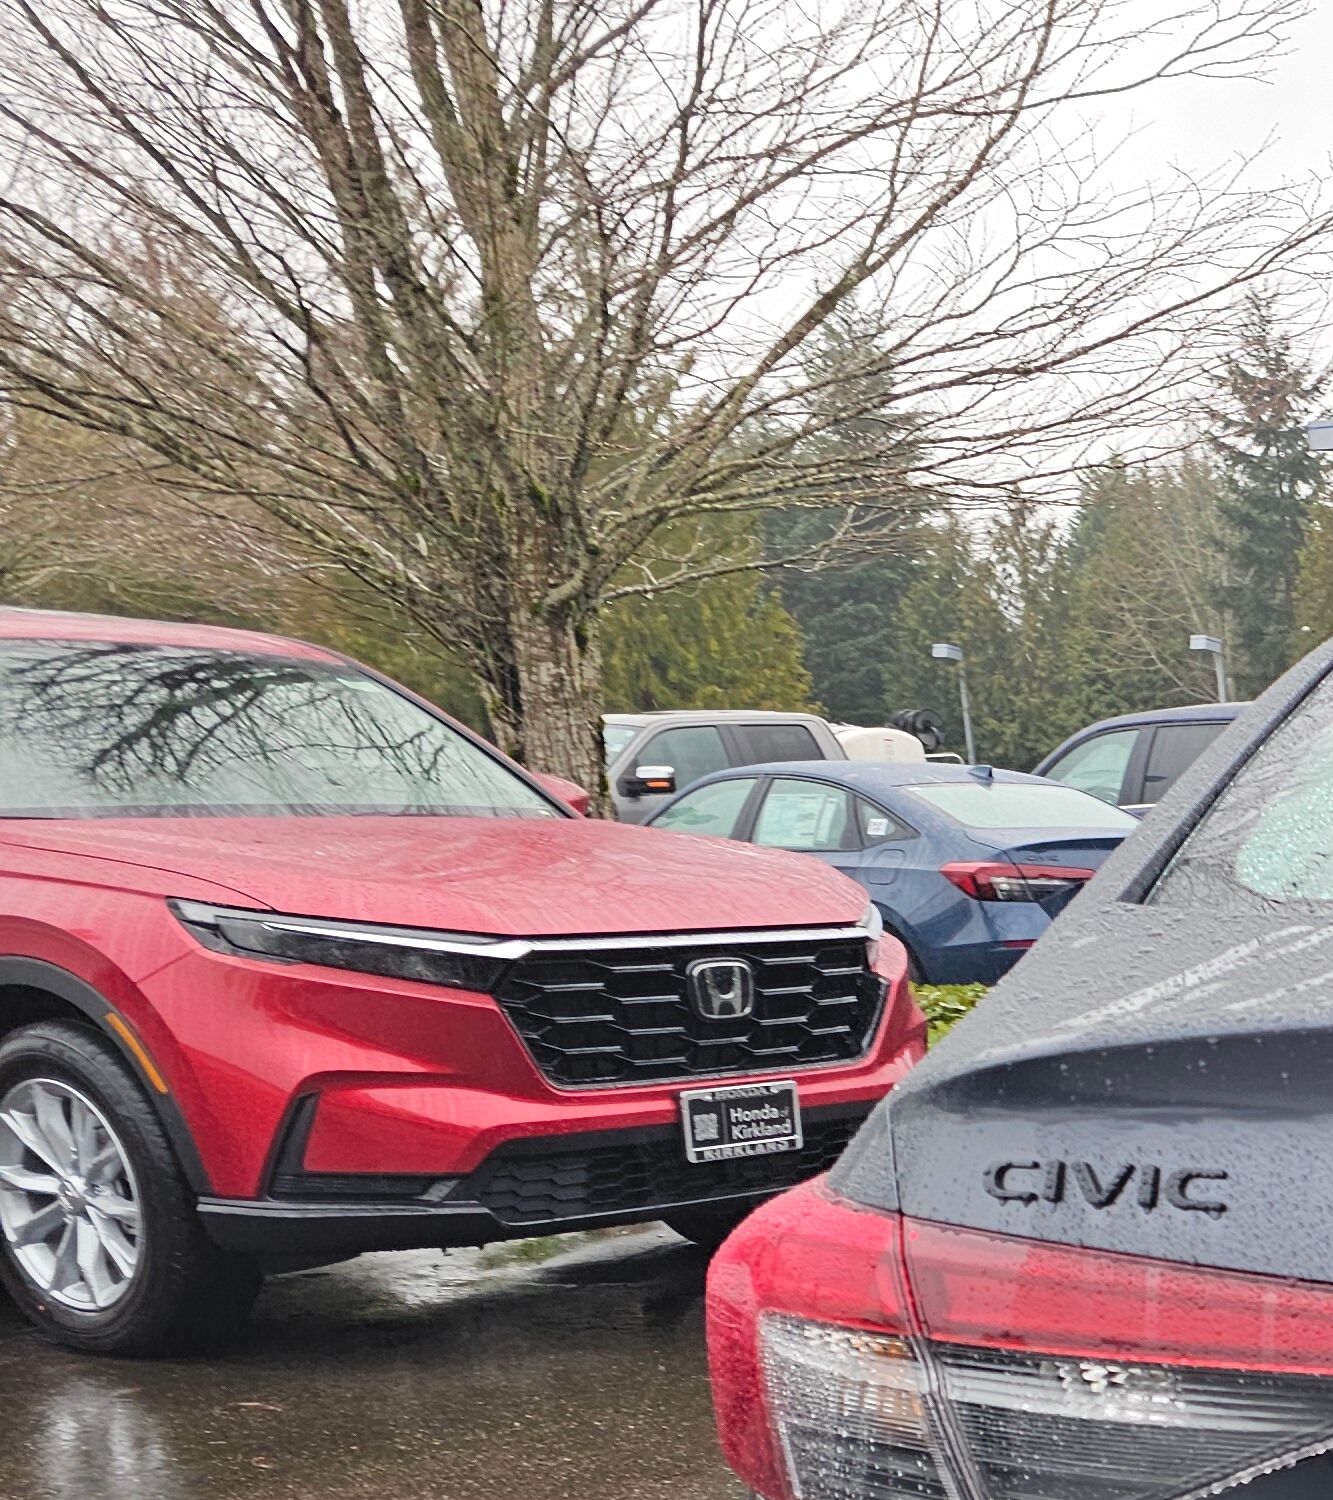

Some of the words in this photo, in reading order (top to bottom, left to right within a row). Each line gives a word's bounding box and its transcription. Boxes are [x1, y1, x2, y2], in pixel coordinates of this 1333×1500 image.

[729, 1103, 779, 1123] Honda
[731, 1119, 792, 1140] Kirkland
[983, 1161, 1229, 1214] CIVIC
